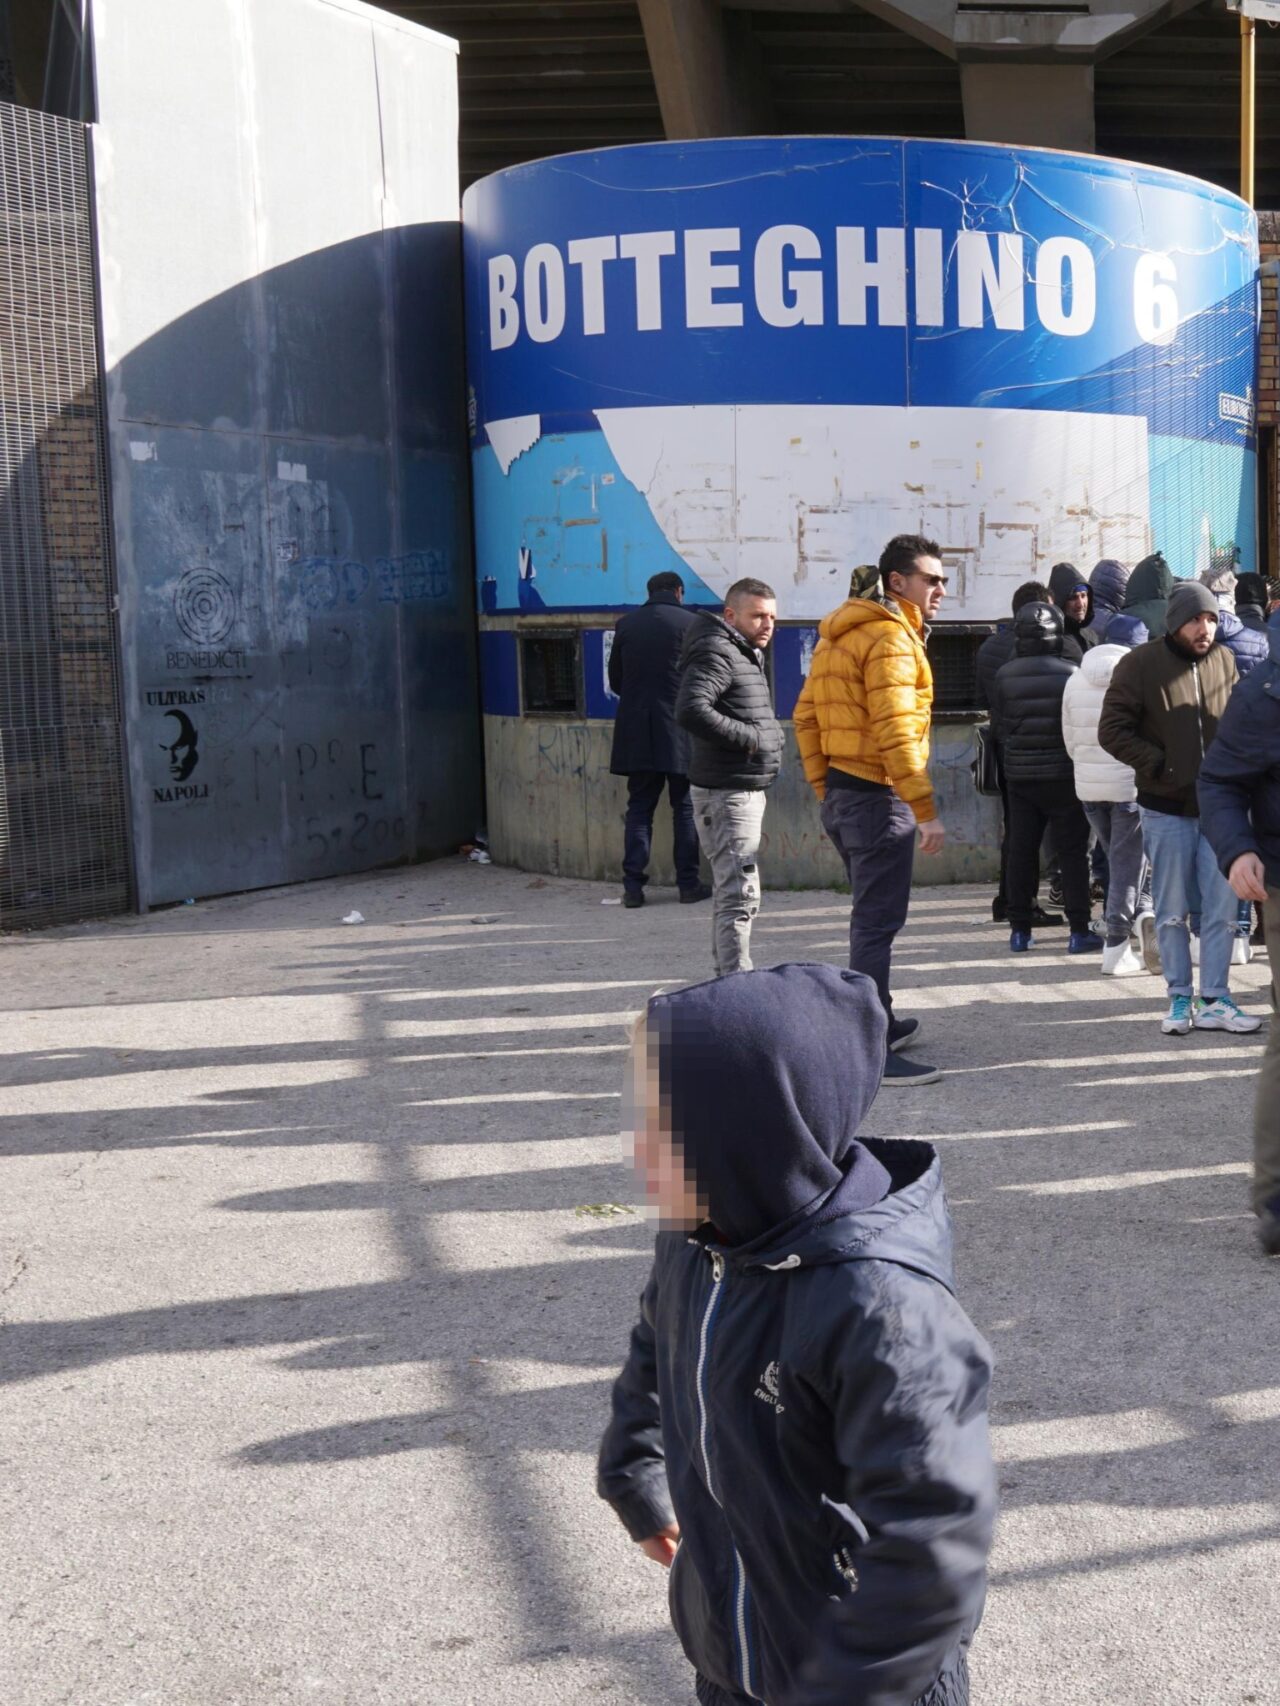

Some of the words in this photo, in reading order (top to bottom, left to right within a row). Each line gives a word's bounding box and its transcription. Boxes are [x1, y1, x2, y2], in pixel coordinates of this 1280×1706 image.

[488, 224, 1096, 351] BOTTEGHINO
[1132, 252, 1180, 347] 6
[145, 690, 206, 706] ULTRAS
[153, 784, 209, 803] NAPOLI
